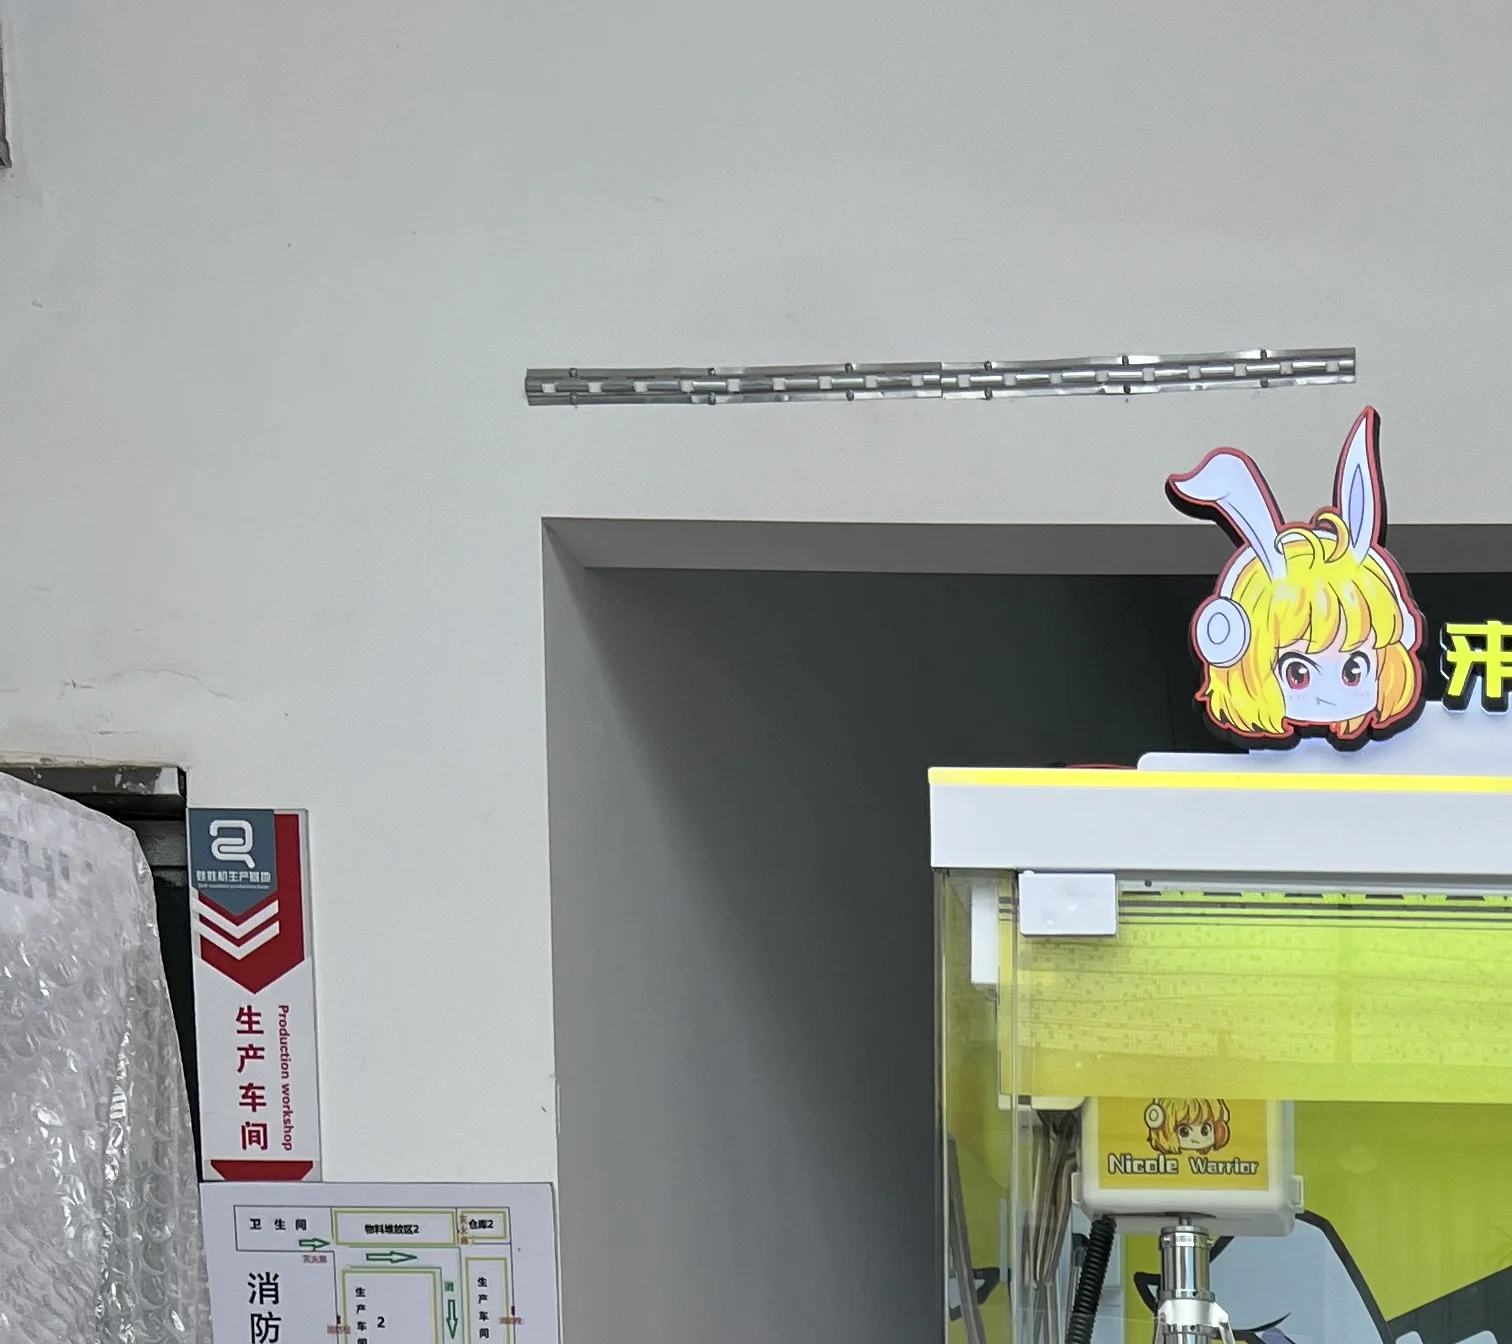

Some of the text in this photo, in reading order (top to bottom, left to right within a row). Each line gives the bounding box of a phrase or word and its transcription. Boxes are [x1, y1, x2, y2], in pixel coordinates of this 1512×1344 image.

[235, 1005, 268, 1152] 生产车间
[278, 1005, 294, 1151] Production workshop
[1108, 1153, 1259, 1175] Nicole Warrior
[250, 1218, 307, 1231] 卫生间
[468, 1219, 494, 1230] 仓库2
[377, 1317, 386, 1328] 2
